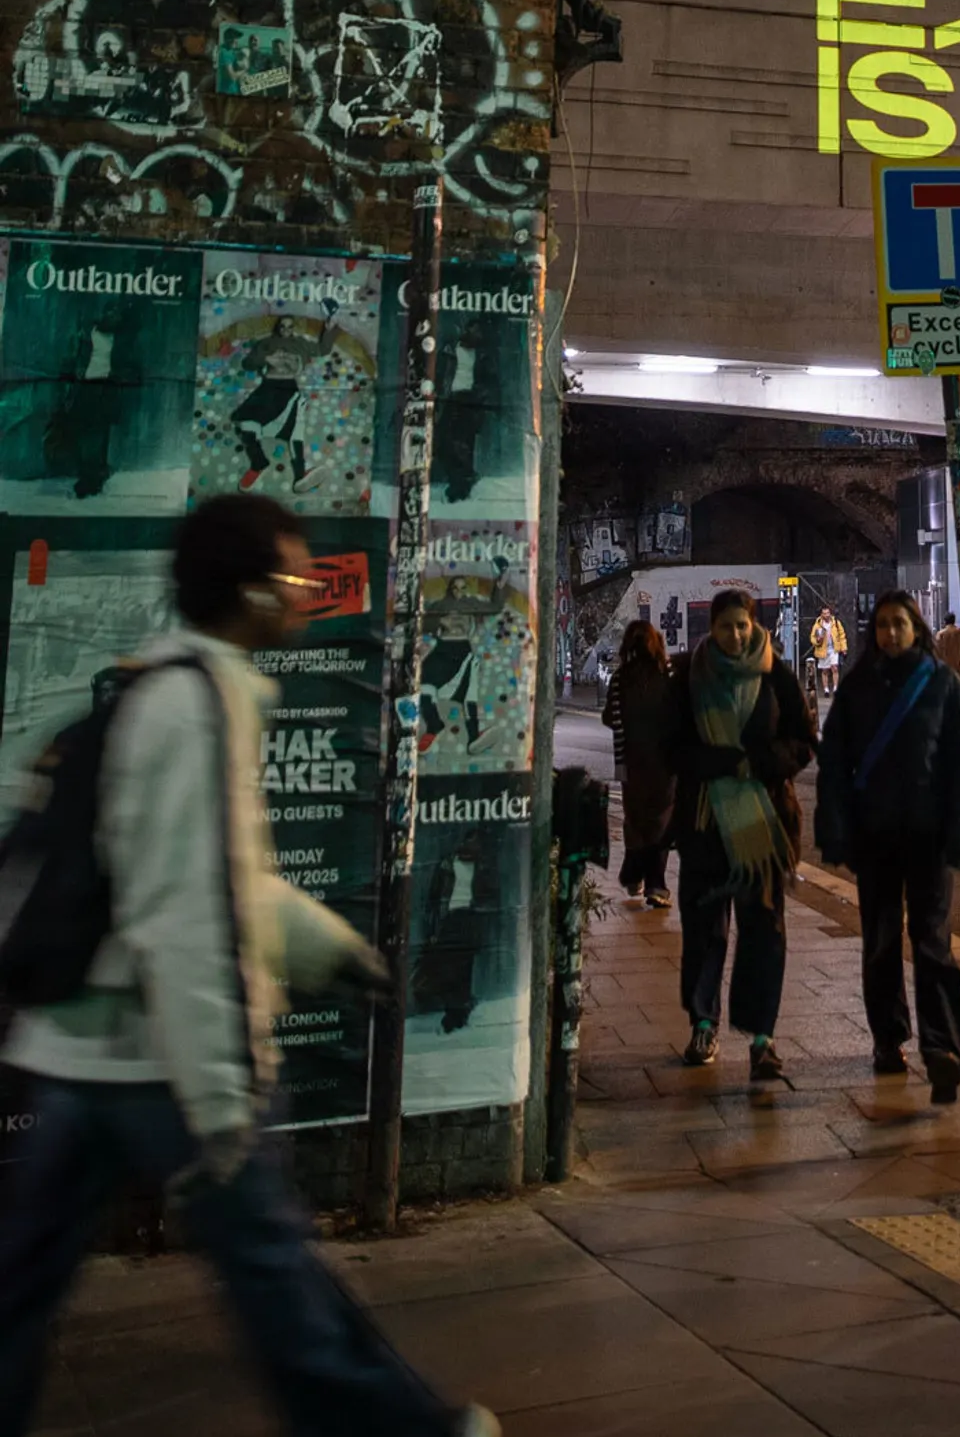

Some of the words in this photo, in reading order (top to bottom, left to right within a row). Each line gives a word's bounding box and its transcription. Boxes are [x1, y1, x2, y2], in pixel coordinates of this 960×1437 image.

[817, 47, 957, 159] IS
[26, 261, 182, 297] Outlander.
[253, 649, 325, 663] SUPPORTING
[326, 648, 349, 660] THE
[280, 661, 297, 673] OF
[298, 660, 366, 673] TOMORROW
[260, 760, 358, 794] AKER
[283, 804, 344, 822] GUESTS
[414, 789, 531, 824] utlander.
[264, 848, 325, 866] SUNDAY
[302, 869, 340, 887] 2025
[281, 1010, 340, 1028] LONDON
